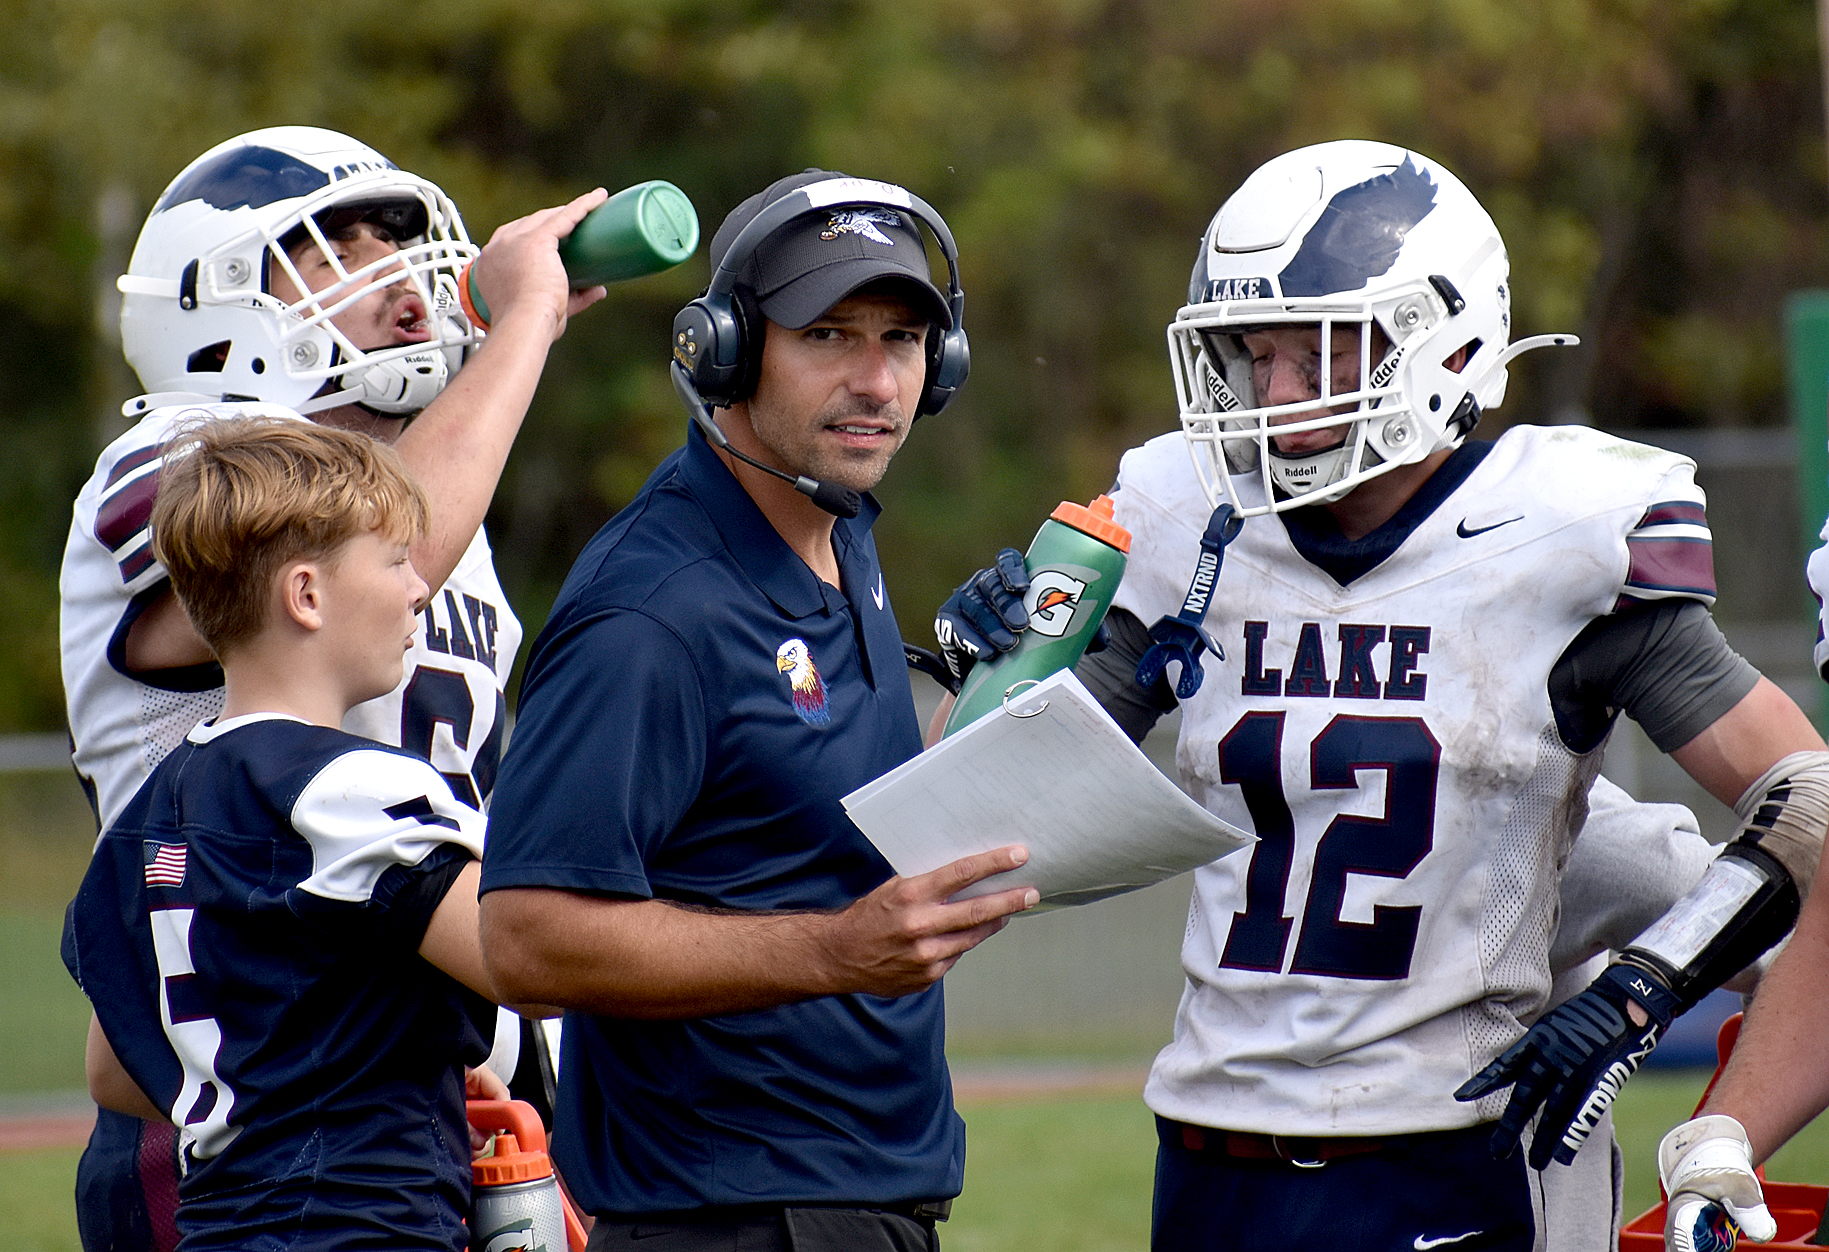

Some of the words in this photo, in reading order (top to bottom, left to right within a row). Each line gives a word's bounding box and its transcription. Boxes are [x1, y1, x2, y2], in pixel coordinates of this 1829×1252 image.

[1211, 279, 1261, 301] LAKE
[1284, 465, 1317, 477] Riddell
[1023, 570, 1087, 637] G
[1184, 552, 1218, 614] NXTRND
[425, 588, 499, 677] LAKE
[1241, 620, 1431, 701] LAKE
[1217, 710, 1442, 980] 12
